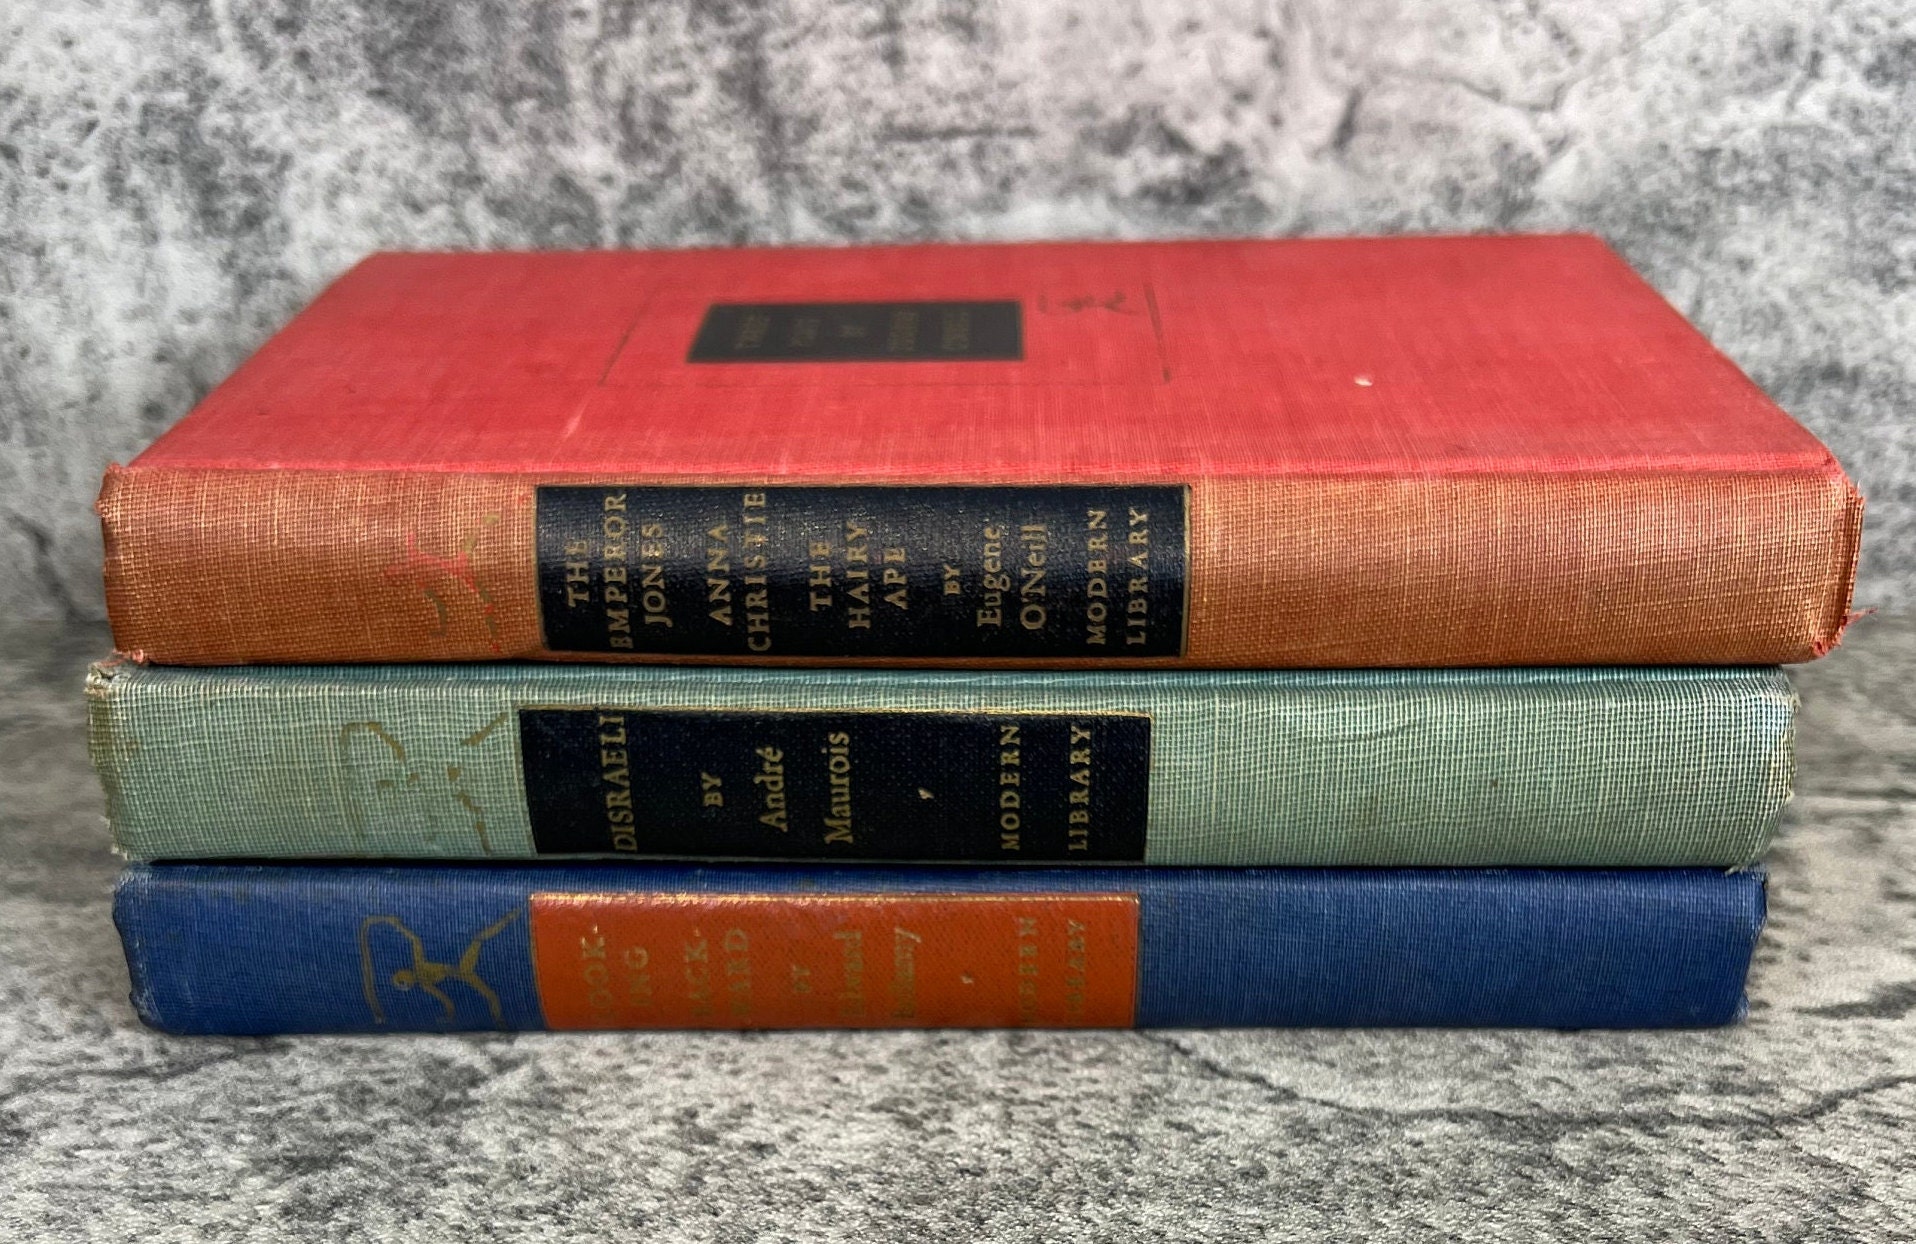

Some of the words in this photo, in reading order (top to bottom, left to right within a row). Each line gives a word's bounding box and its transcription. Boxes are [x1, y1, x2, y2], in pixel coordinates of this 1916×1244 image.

[565, 540, 591, 608] THE
[604, 493, 634, 649] EMPEROR
[641, 522, 673, 627] JONES
[707, 524, 732, 626] ANNA
[743, 493, 772, 651] CHRISTIE
[809, 541, 832, 612] THE
[846, 520, 871, 629] HAIRY
[883, 547, 908, 610] APE
[942, 563, 961, 595] BY
[977, 525, 1011, 627] Eugene
[1019, 523, 1048, 630] O'Neill
[1086, 508, 1108, 645] MODERN
[1127, 507, 1149, 645] LIBRARY
[600, 715, 637, 851] DISRAELI
[701, 771, 724, 807] BY
[754, 746, 788, 833] André
[821, 731, 854, 844] Maurois
[1000, 724, 1020, 850] MODERN
[1068, 725, 1091, 850] LIBRARY
[580, 924, 614, 1021] OOK-
[684, 928, 713, 1016] ACK-
[1018, 917, 1038, 1023] DERN
